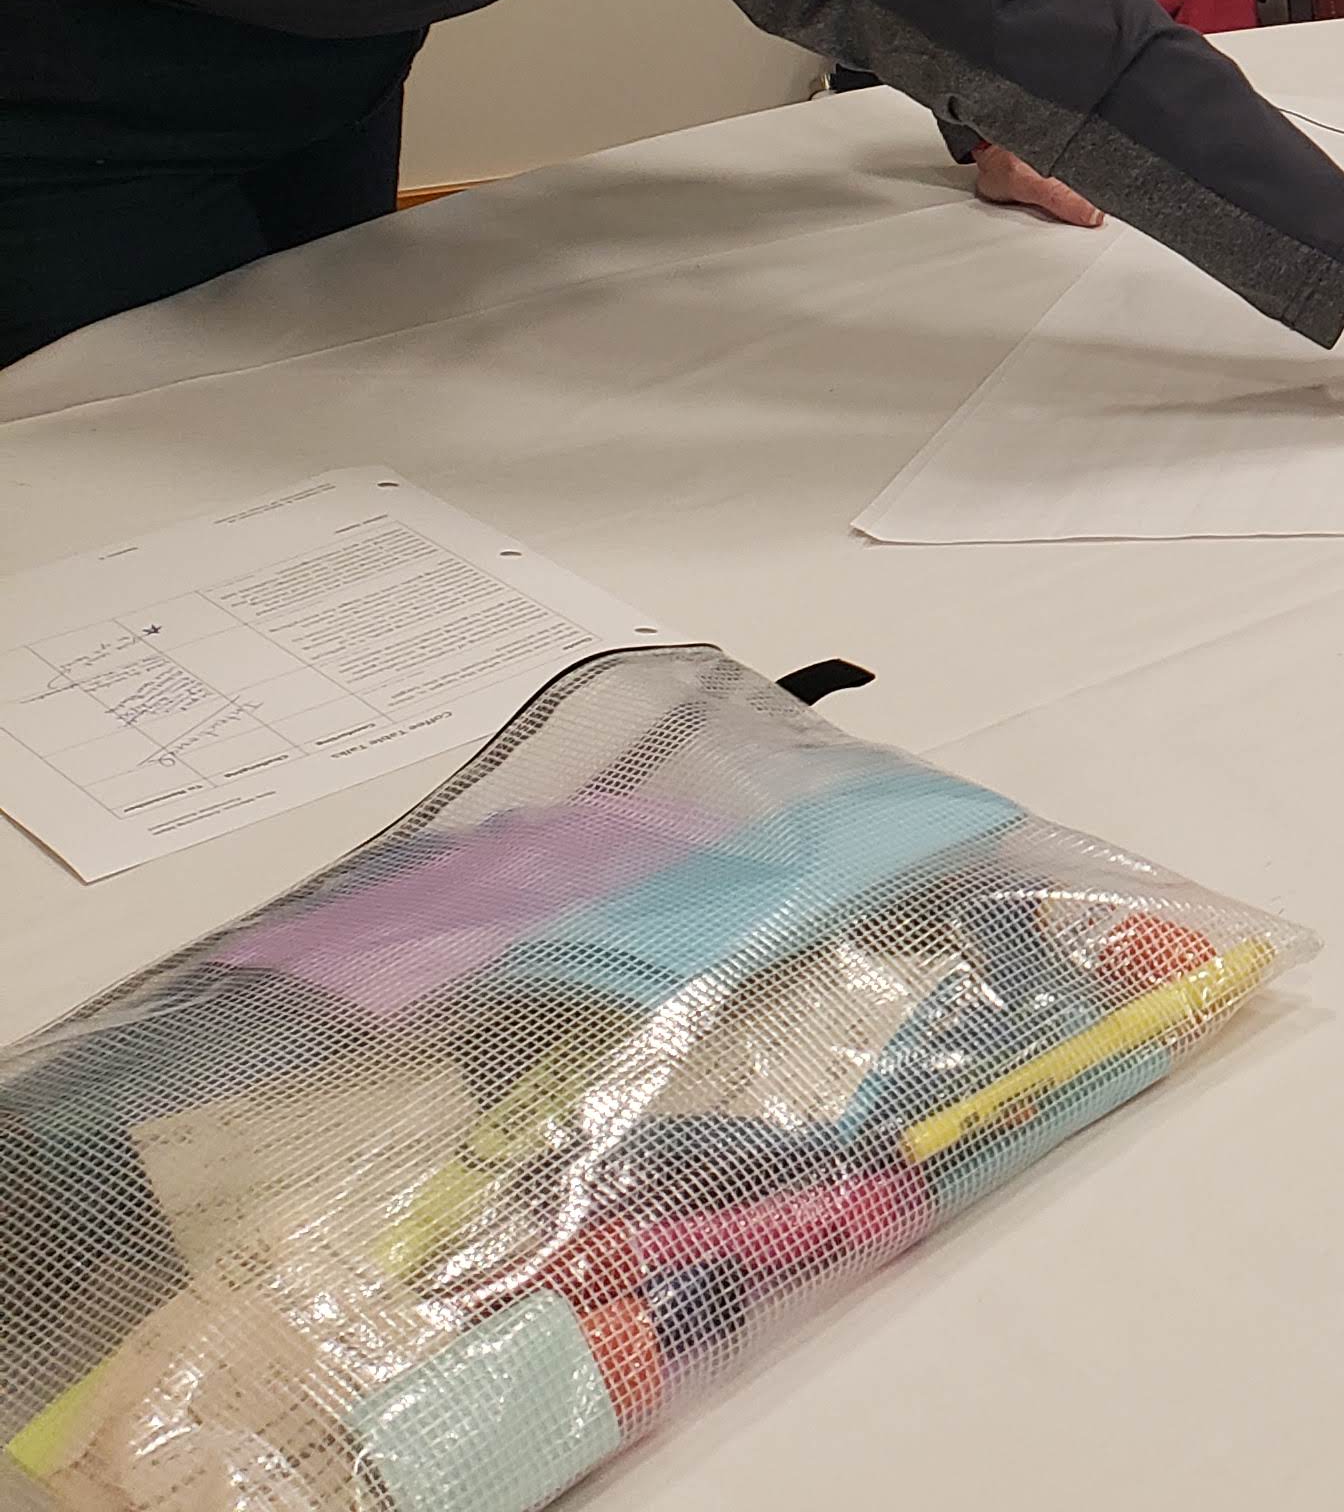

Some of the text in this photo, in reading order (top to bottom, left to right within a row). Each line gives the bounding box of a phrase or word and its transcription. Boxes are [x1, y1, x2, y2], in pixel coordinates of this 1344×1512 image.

[330, 710, 453, 759] Coffee Table Talks
